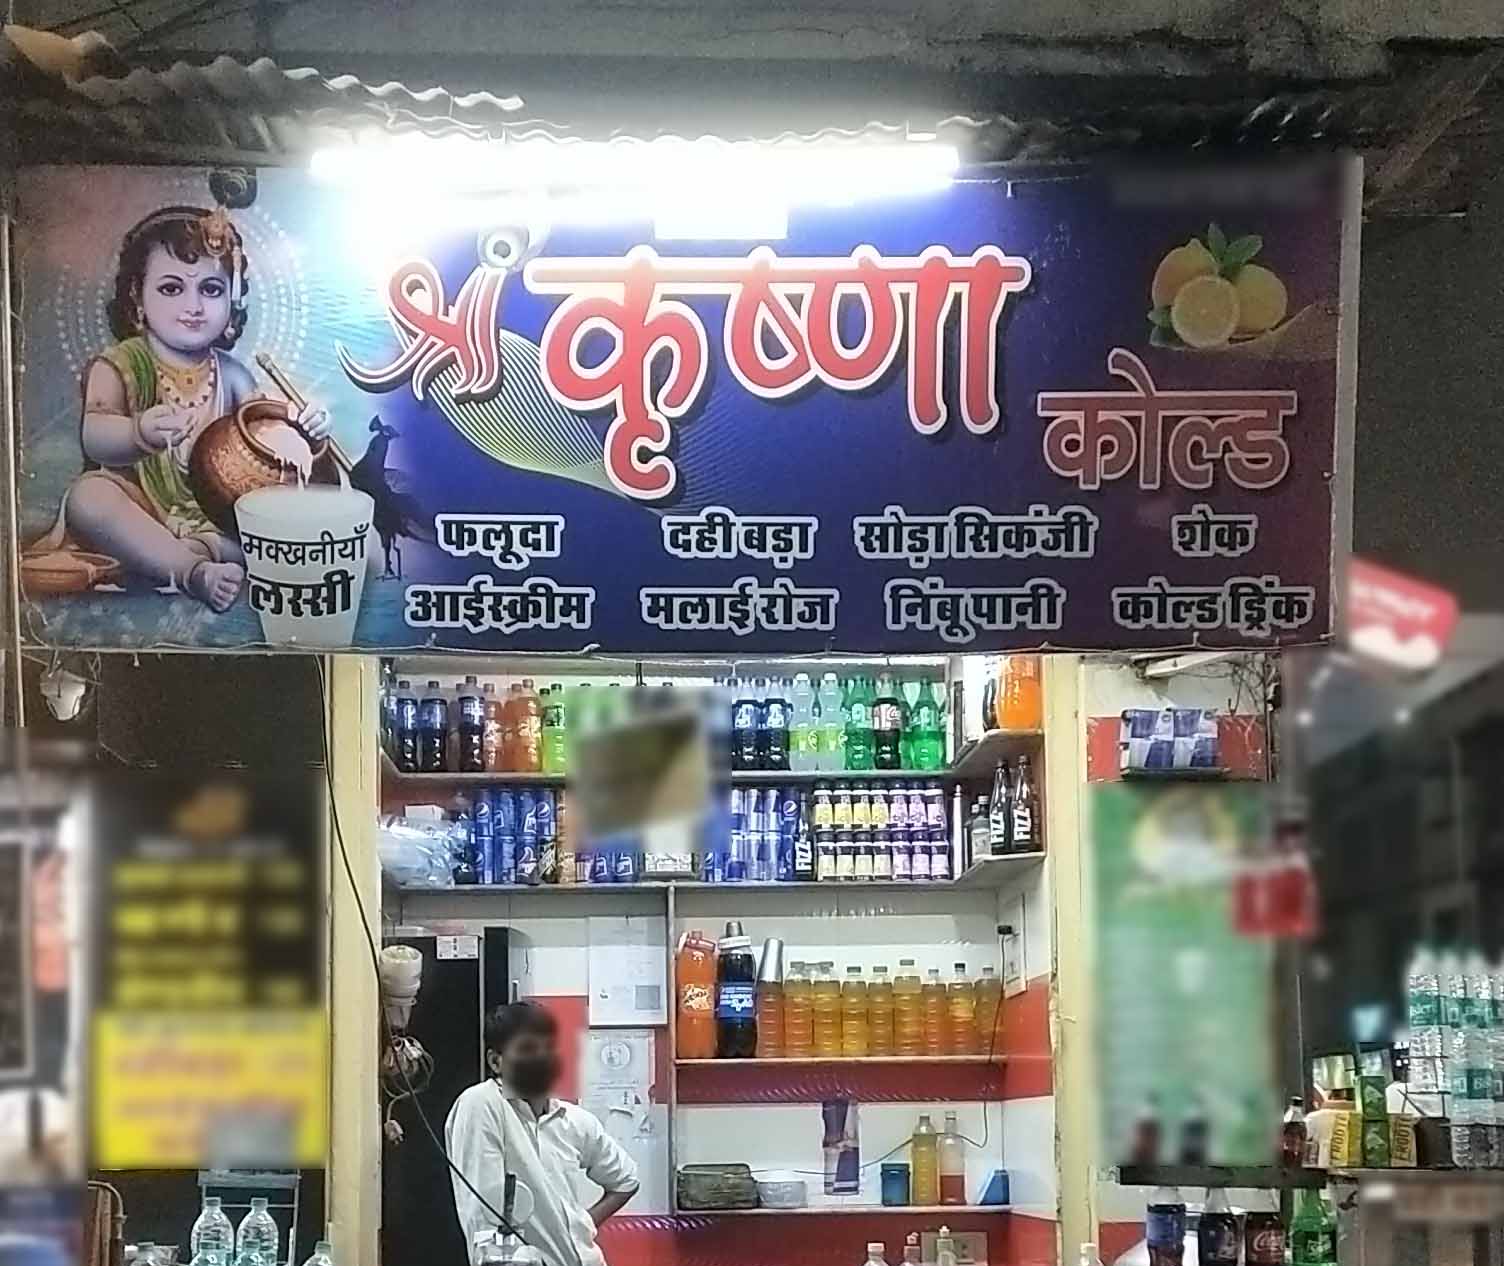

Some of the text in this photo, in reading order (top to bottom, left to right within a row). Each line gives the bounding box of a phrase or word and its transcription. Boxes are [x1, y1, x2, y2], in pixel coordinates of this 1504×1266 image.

[523, 245, 1030, 499] कृष्णा
[1038, 348, 1297, 489] कोल्ड
[438, 516, 562, 567] फलूदा
[666, 510, 736, 554] दही
[952, 507, 1095, 554] सिकंजी
[1175, 507, 1255, 554] शेक
[248, 568, 356, 618] लस्सी
[408, 579, 592, 630] आईस्क्रीम
[643, 580, 836, 631] मलाई रोज
[888, 581, 1063, 640] निंबू पानी
[1115, 580, 1223, 627] कोल्ड
[1227, 579, 1312, 634] ड्रिंक
[990, 811, 1004, 843] FIZZ
[1013, 807, 1031, 840] FIZZ
[794, 841, 811, 870] FIZZ
